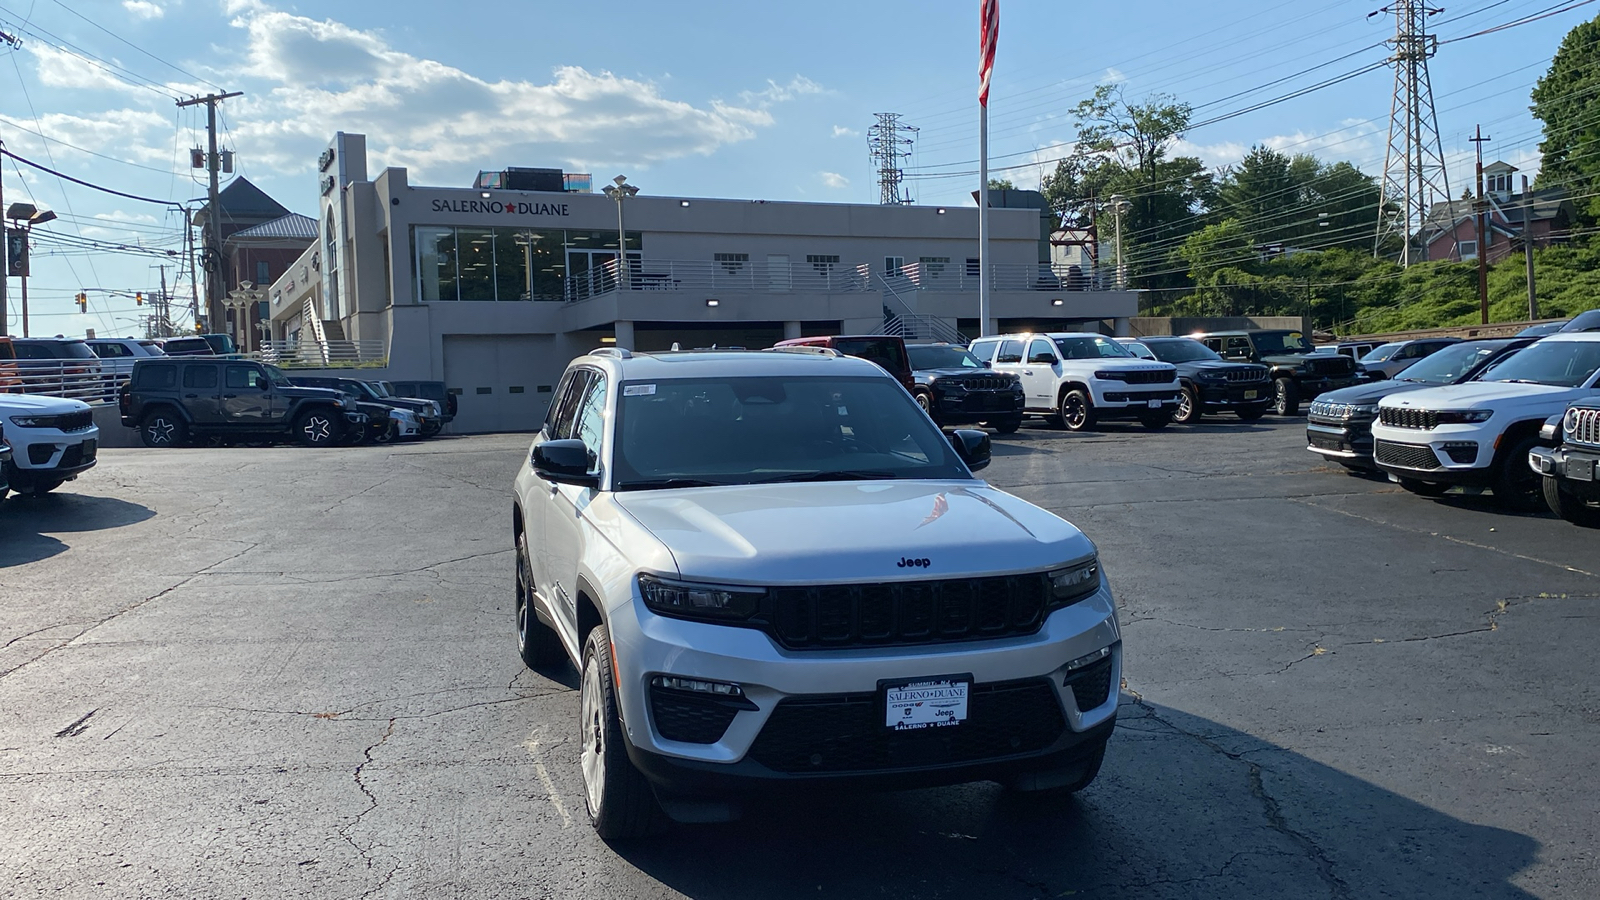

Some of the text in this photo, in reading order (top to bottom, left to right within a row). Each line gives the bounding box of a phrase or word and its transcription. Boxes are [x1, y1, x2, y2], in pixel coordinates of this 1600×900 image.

[432, 199, 570, 216] SALERNO DUANE
[897, 556, 930, 568] Jeep
[889, 689, 965, 701] SALERNO DUANE
[935, 709, 954, 717] Jeep
